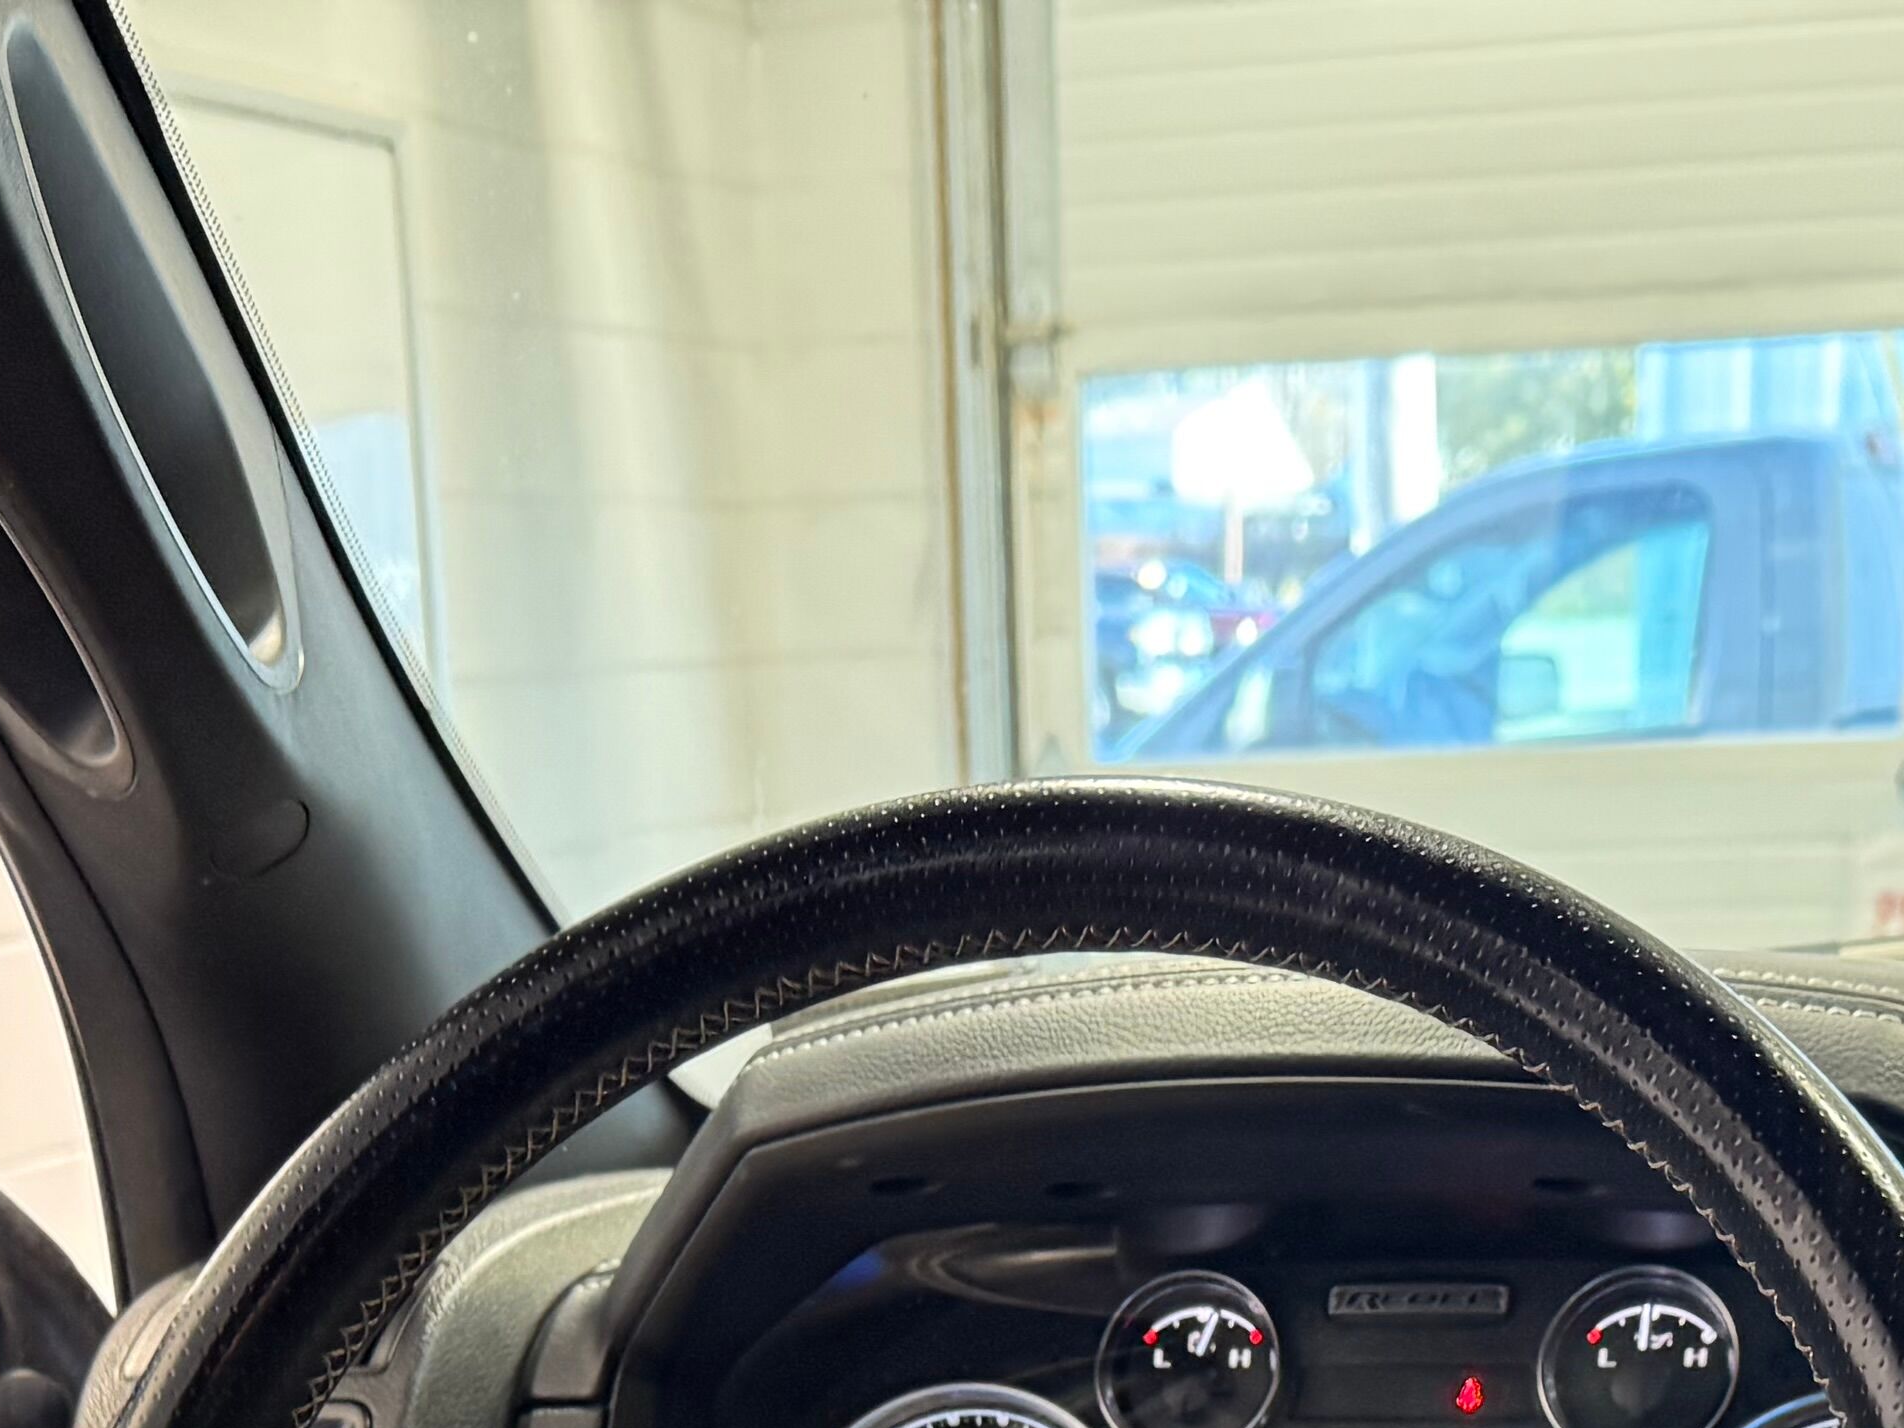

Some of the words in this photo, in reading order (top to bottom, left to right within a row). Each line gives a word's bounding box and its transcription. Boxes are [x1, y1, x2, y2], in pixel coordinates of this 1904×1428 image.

[1152, 1348, 1173, 1370] L
[1227, 1348, 1252, 1370] H
[1597, 1347, 1618, 1369] L
[1682, 1347, 1709, 1369] H
